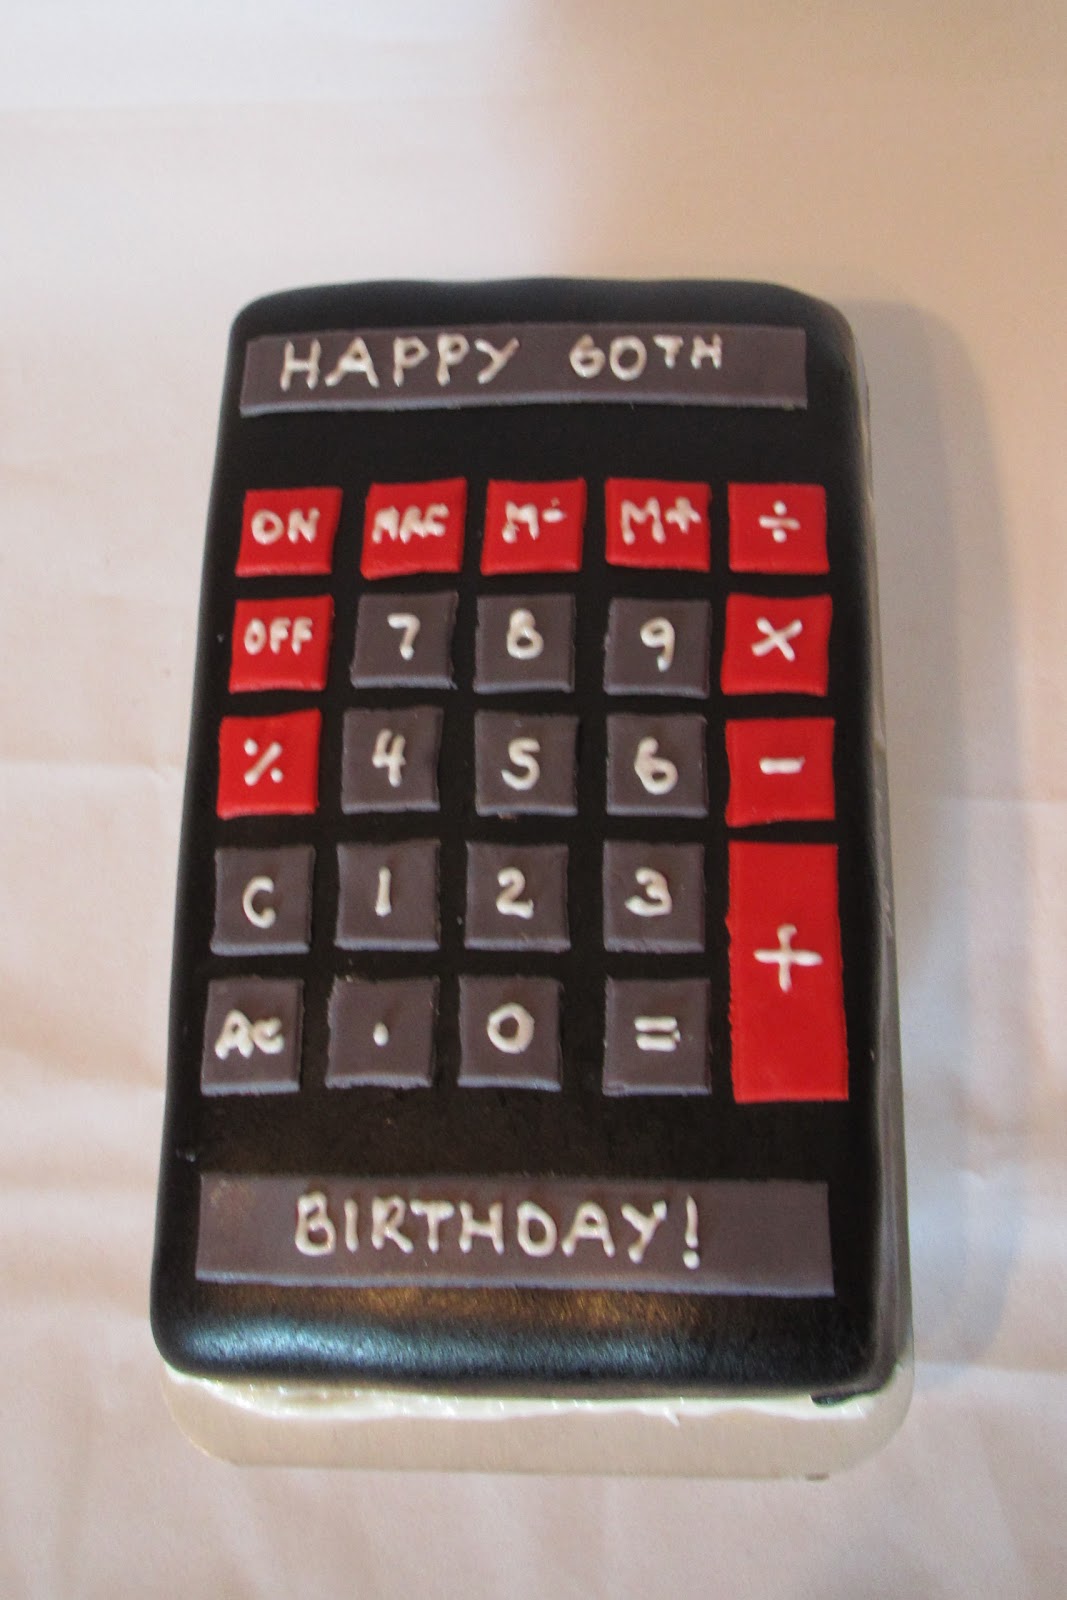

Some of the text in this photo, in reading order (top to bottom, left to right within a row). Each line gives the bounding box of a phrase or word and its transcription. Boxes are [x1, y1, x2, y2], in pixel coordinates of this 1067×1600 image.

[279, 334, 723, 390] HAPPY 60TH
[251, 508, 319, 545] ON
[620, 497, 703, 545] M+
[243, 617, 313, 655] OFF
[387, 613, 421, 661] 7
[506, 609, 543, 660] 8
[640, 618, 676, 672] 9
[243, 738, 284, 786] %
[371, 728, 406, 787] 4
[501, 738, 541, 791] 5
[633, 736, 677, 795] 6
[495, 868, 535, 919] 2
[624, 868, 673, 917] 3
[754, 924, 823, 992] +
[293, 1190, 701, 1271] BIRTHDAY!
